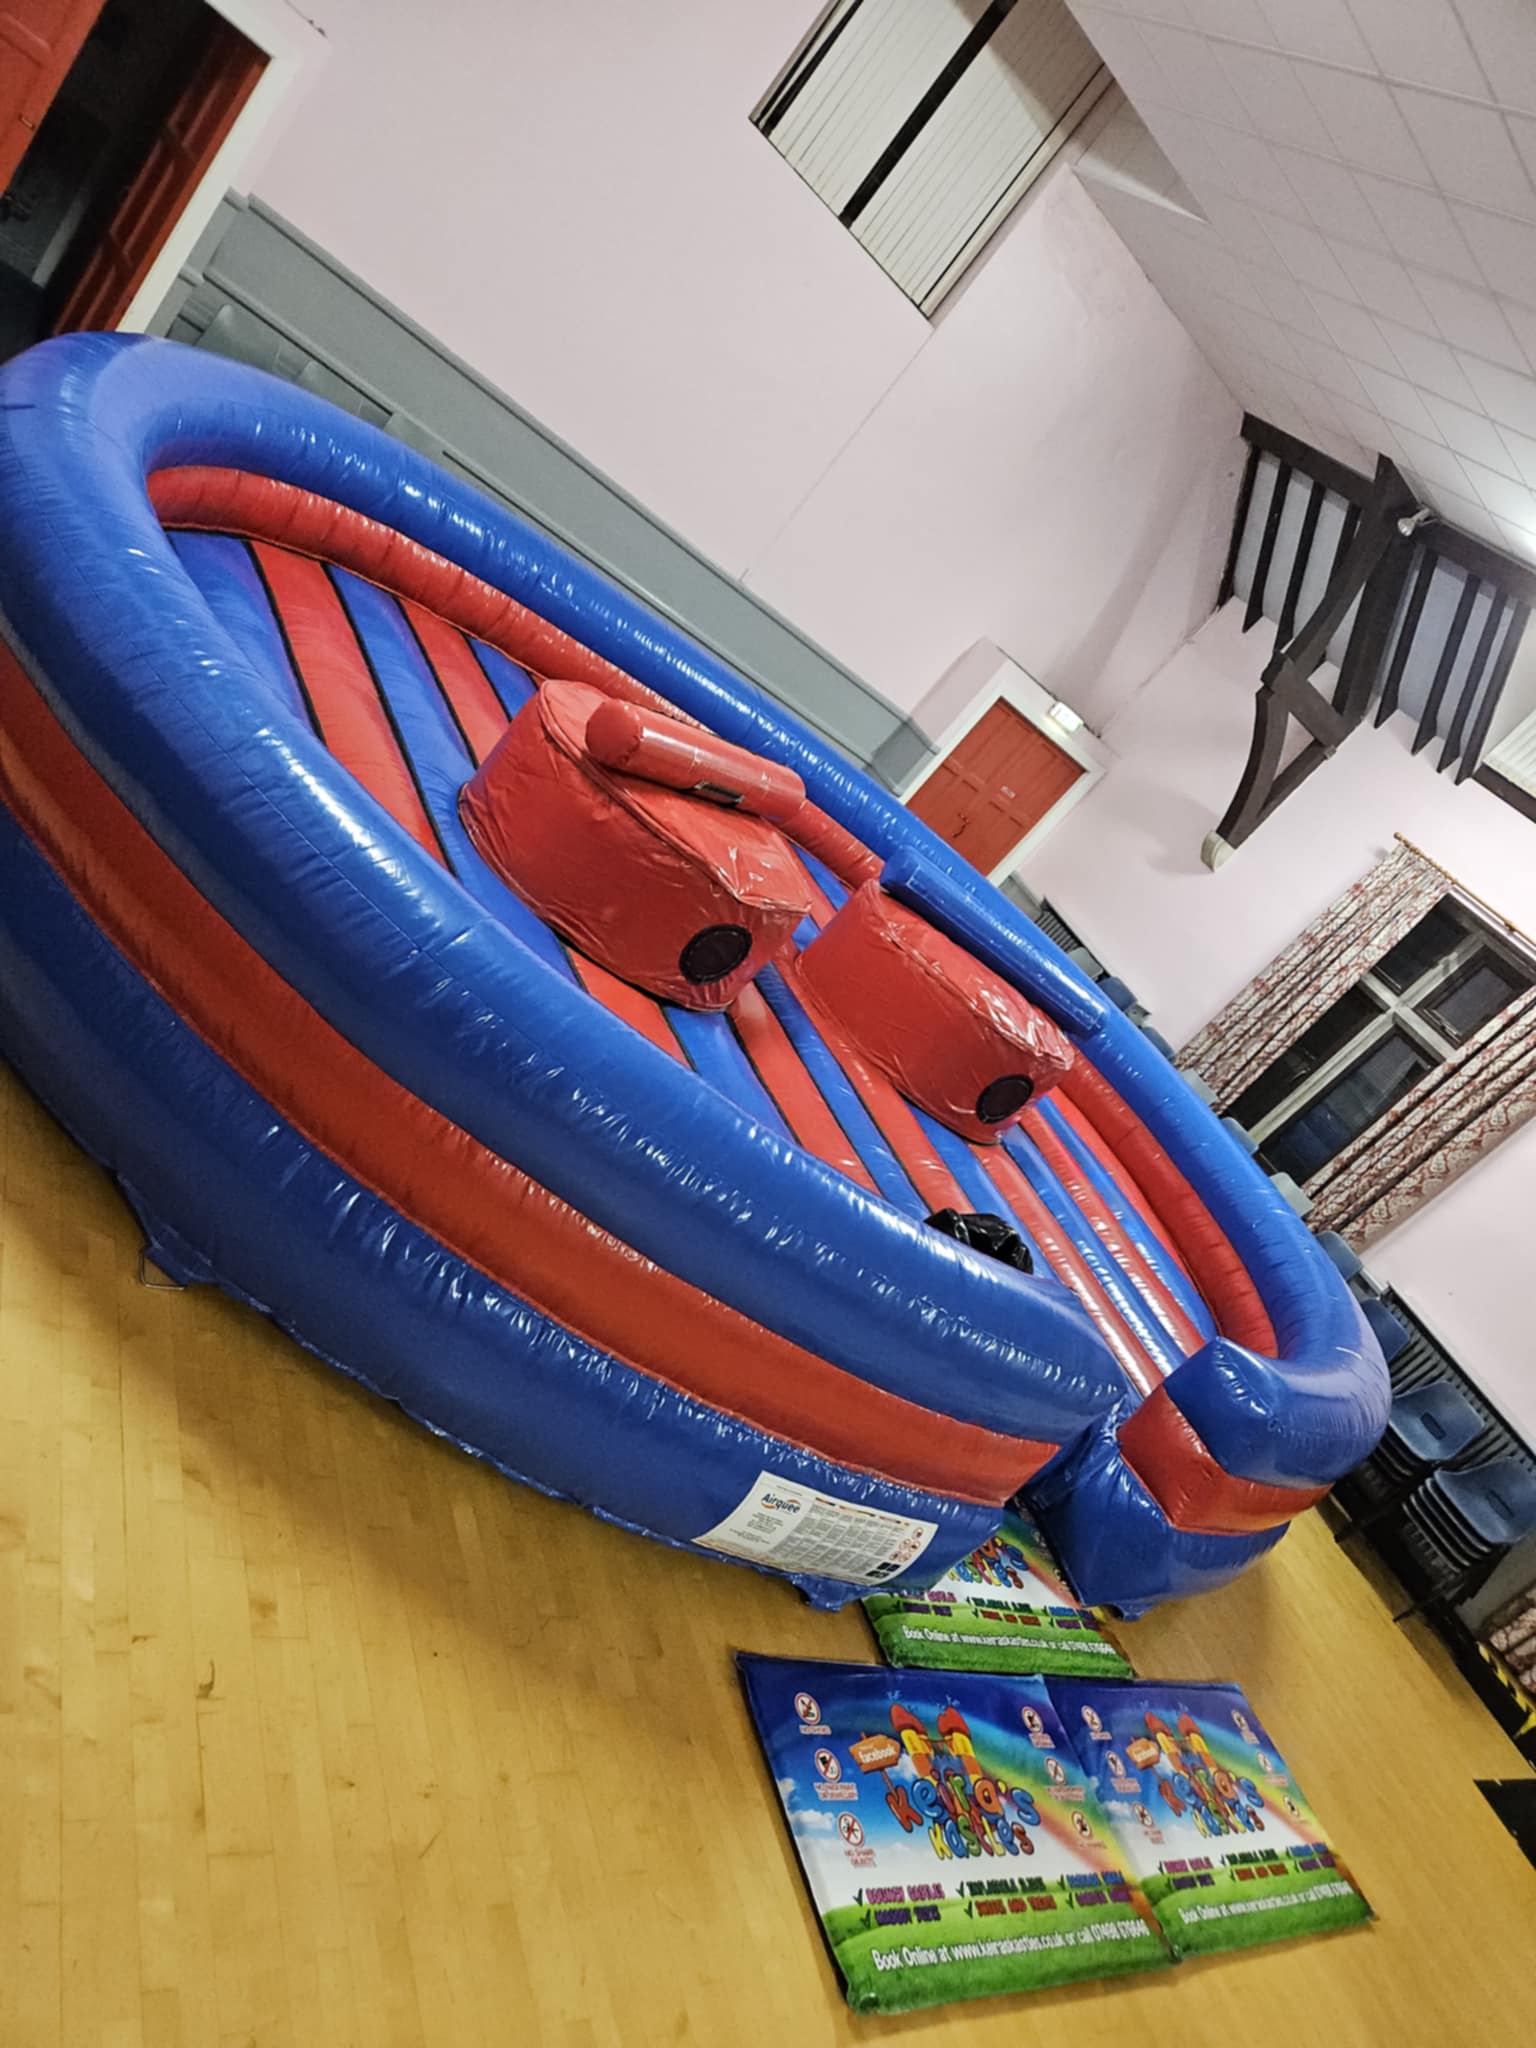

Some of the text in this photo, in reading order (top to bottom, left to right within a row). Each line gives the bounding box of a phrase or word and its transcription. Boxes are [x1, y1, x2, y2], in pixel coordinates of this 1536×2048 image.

[761, 1493, 801, 1513] Airquee
[858, 1744, 897, 1764] facebook
[872, 1948, 903, 1971] Book
[902, 1945, 938, 1967] Online
[937, 1944, 952, 1962] at
[1065, 1932, 1076, 1947] or
